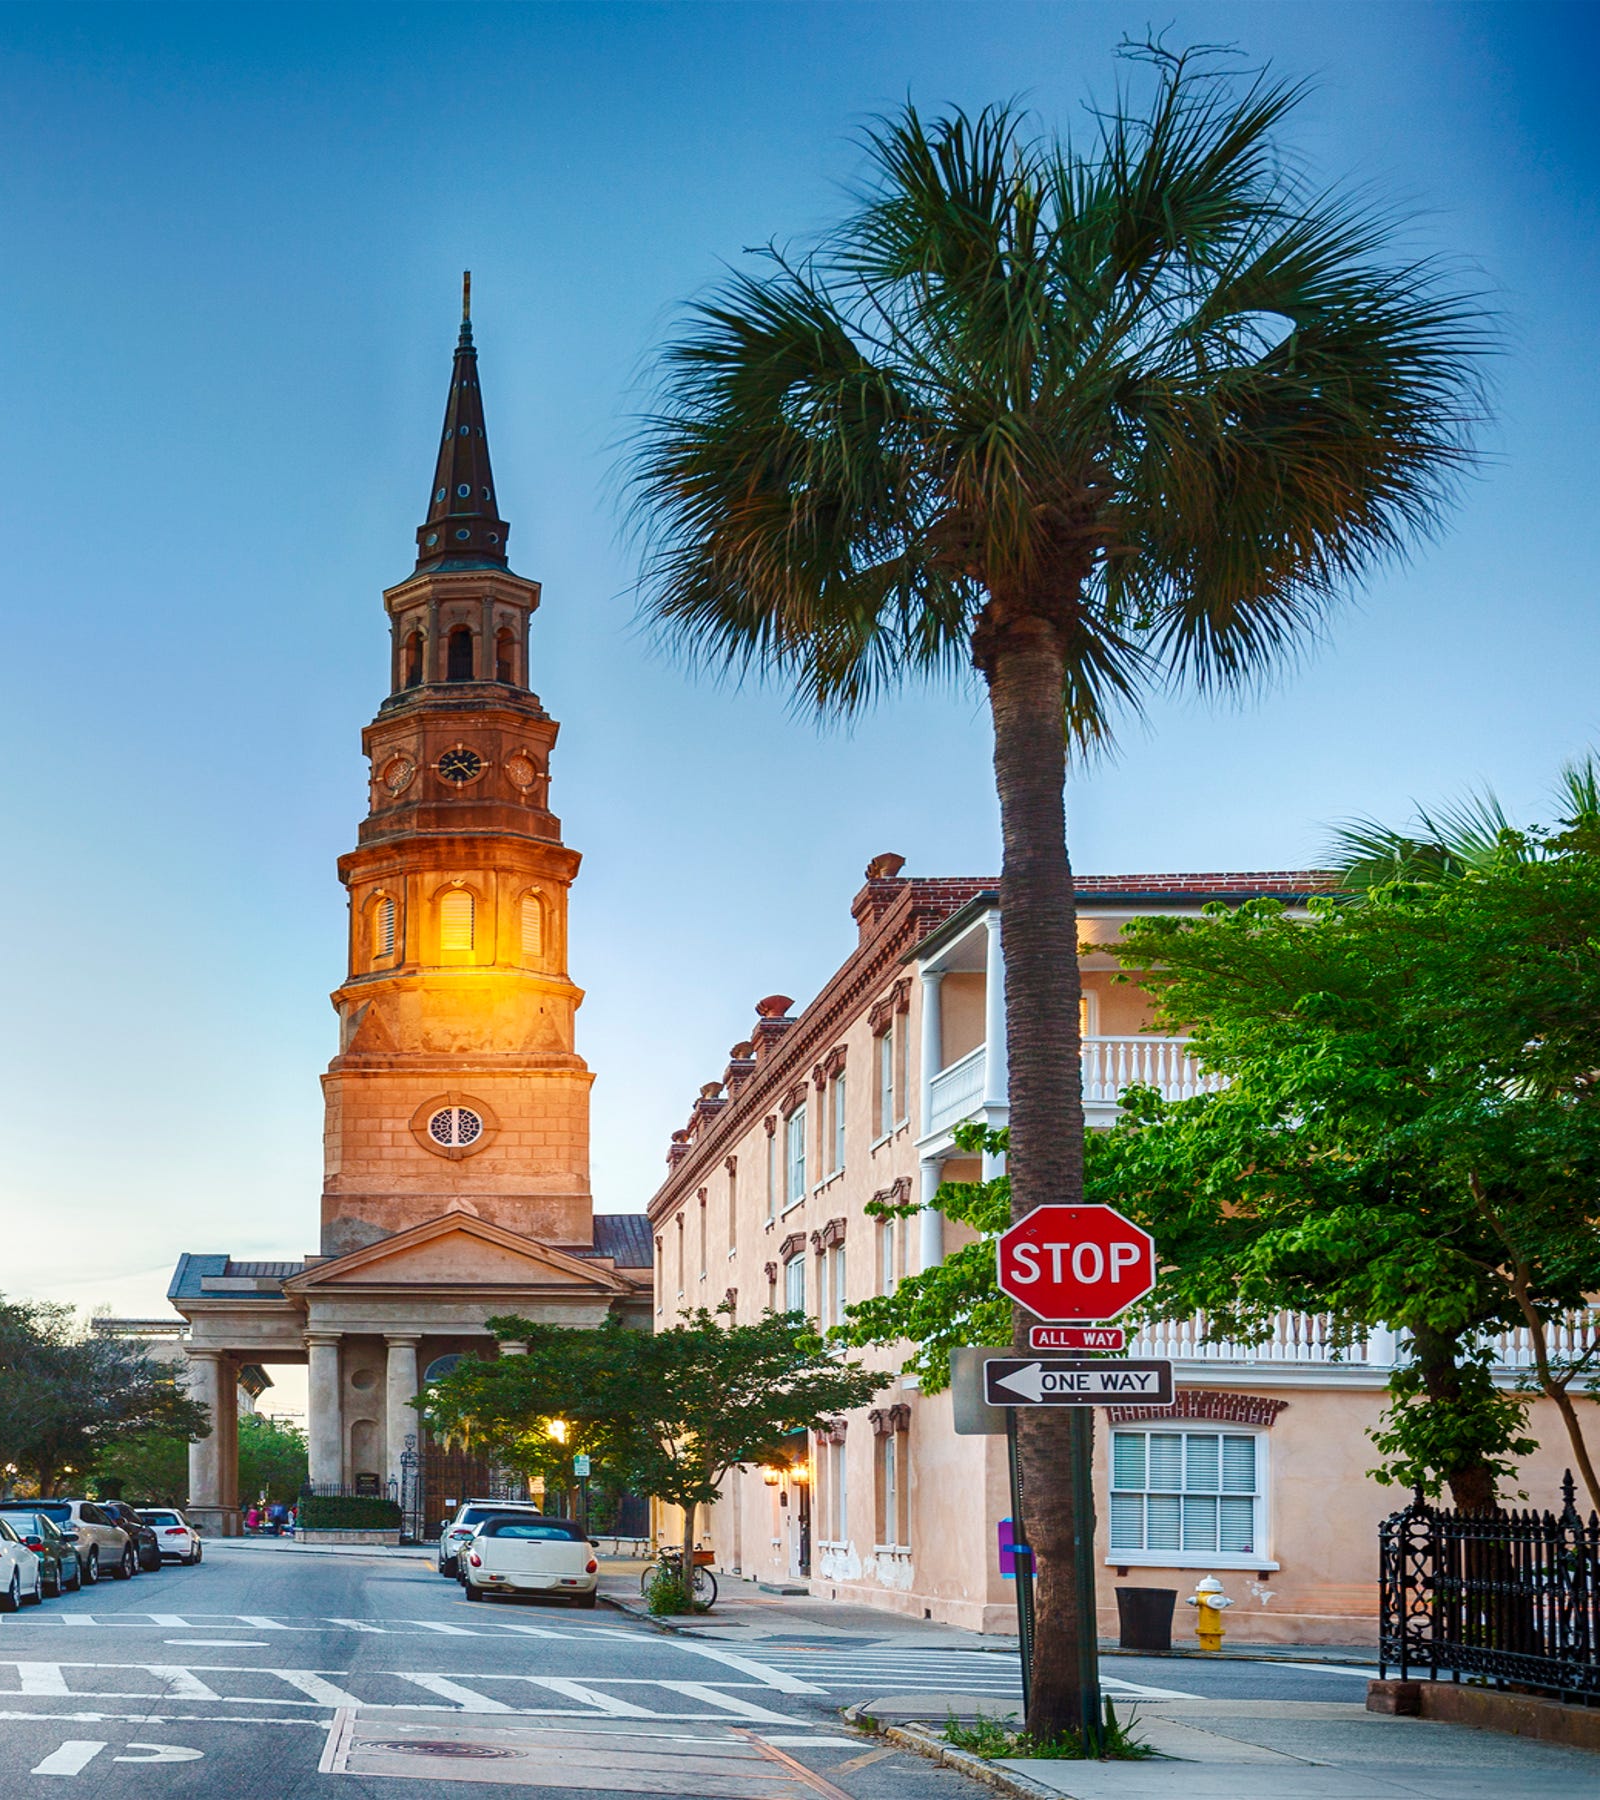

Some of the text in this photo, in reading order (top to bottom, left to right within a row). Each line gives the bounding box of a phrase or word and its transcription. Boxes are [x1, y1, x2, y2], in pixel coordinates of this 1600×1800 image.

[1010, 1241, 1141, 1284] STOP
[1038, 1331, 1117, 1346] ALL WAY
[1041, 1373, 1152, 1391] ONE WAY
